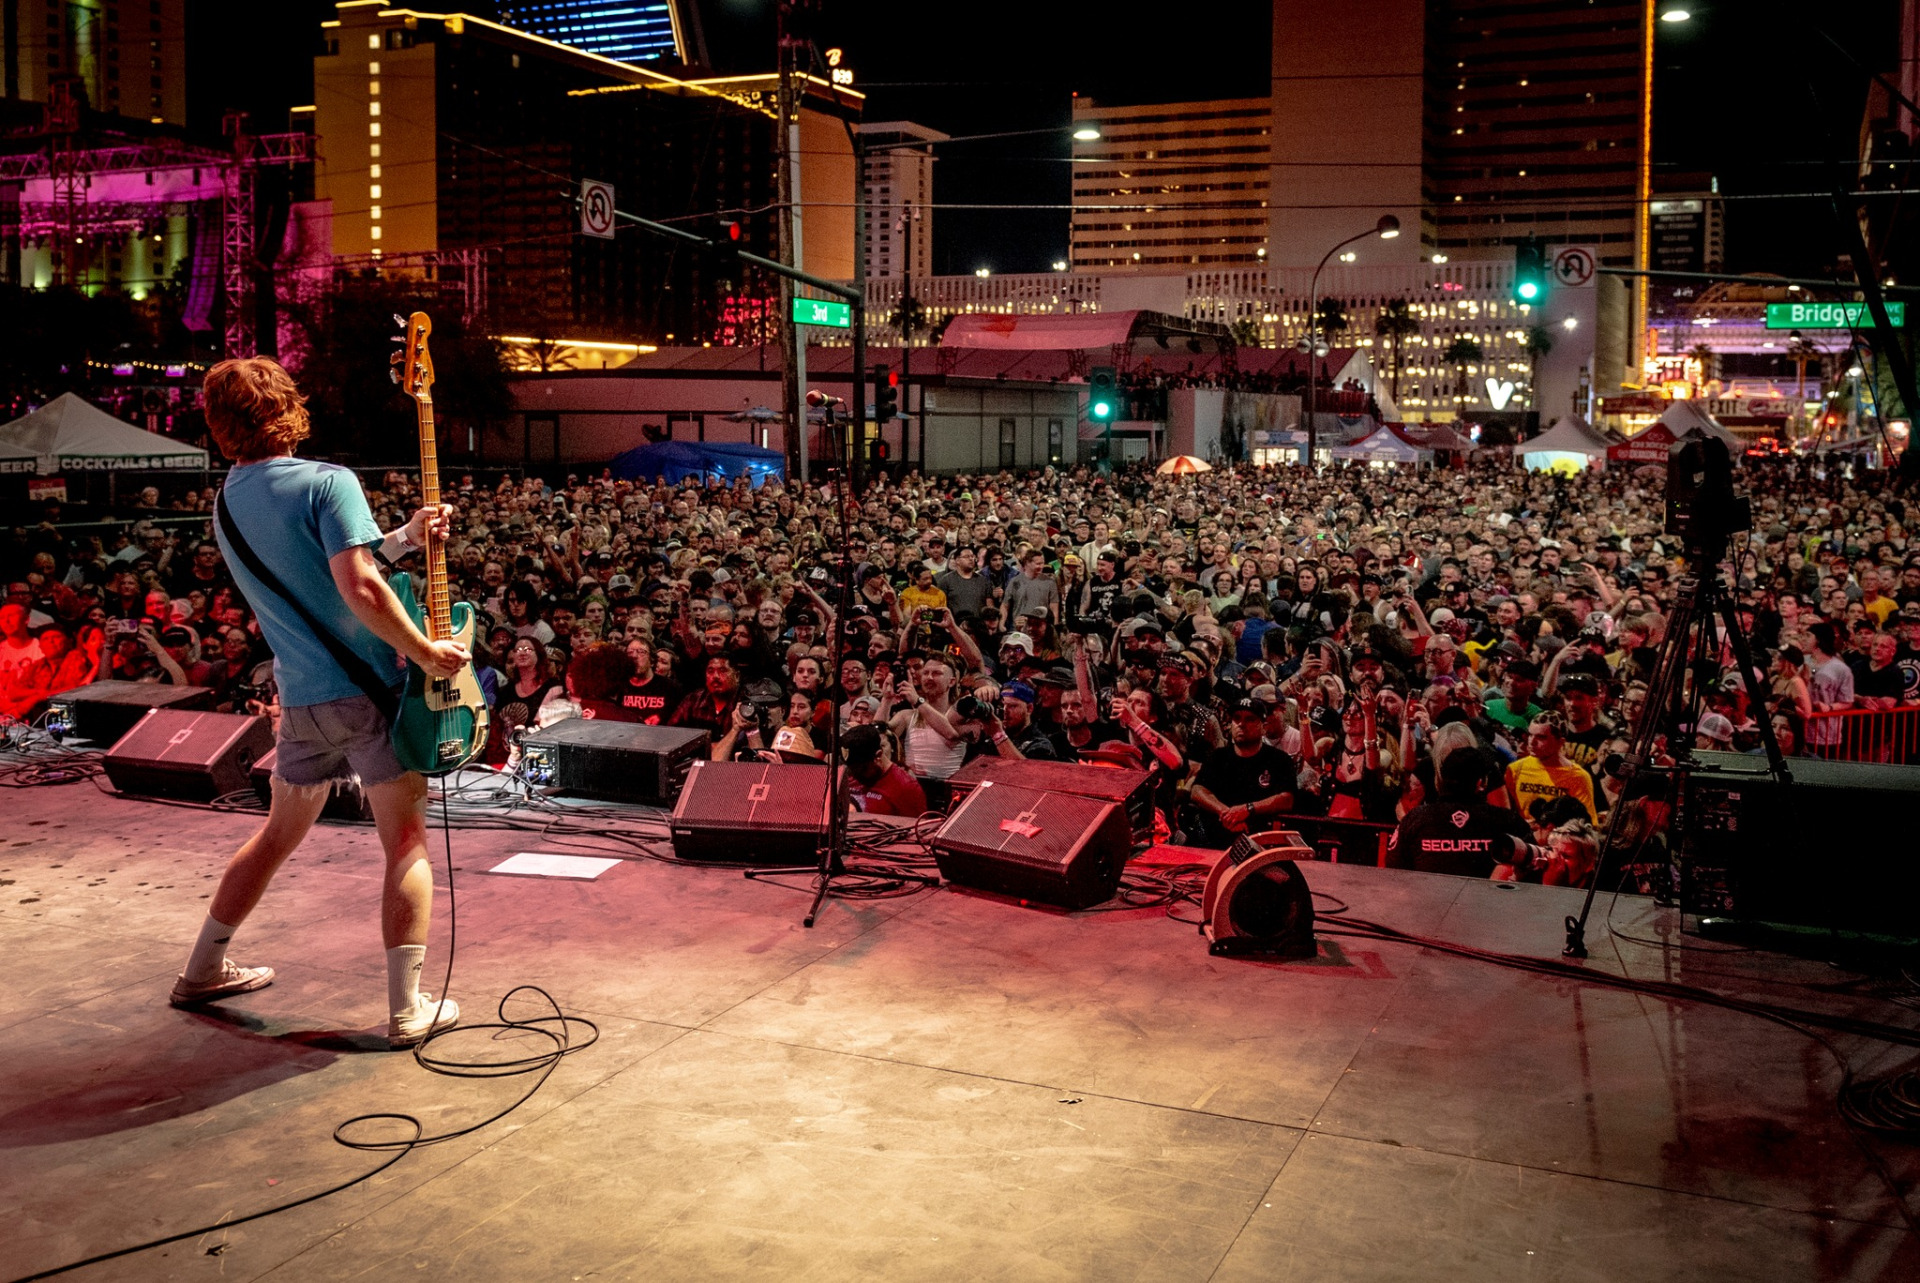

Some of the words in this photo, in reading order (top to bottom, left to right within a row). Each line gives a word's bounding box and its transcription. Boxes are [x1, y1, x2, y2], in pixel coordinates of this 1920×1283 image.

[812, 303, 828, 322] 3rd
[1772, 306, 1778, 315] E
[1791, 303, 1866, 328] Bridger
[1708, 400, 1737, 415] EXIT
[0, 460, 36, 474] EER
[61, 456, 149, 470] COCKTAILS
[151, 456, 162, 469] &
[163, 455, 204, 468] BEER
[1421, 839, 1493, 852] SECURIT
